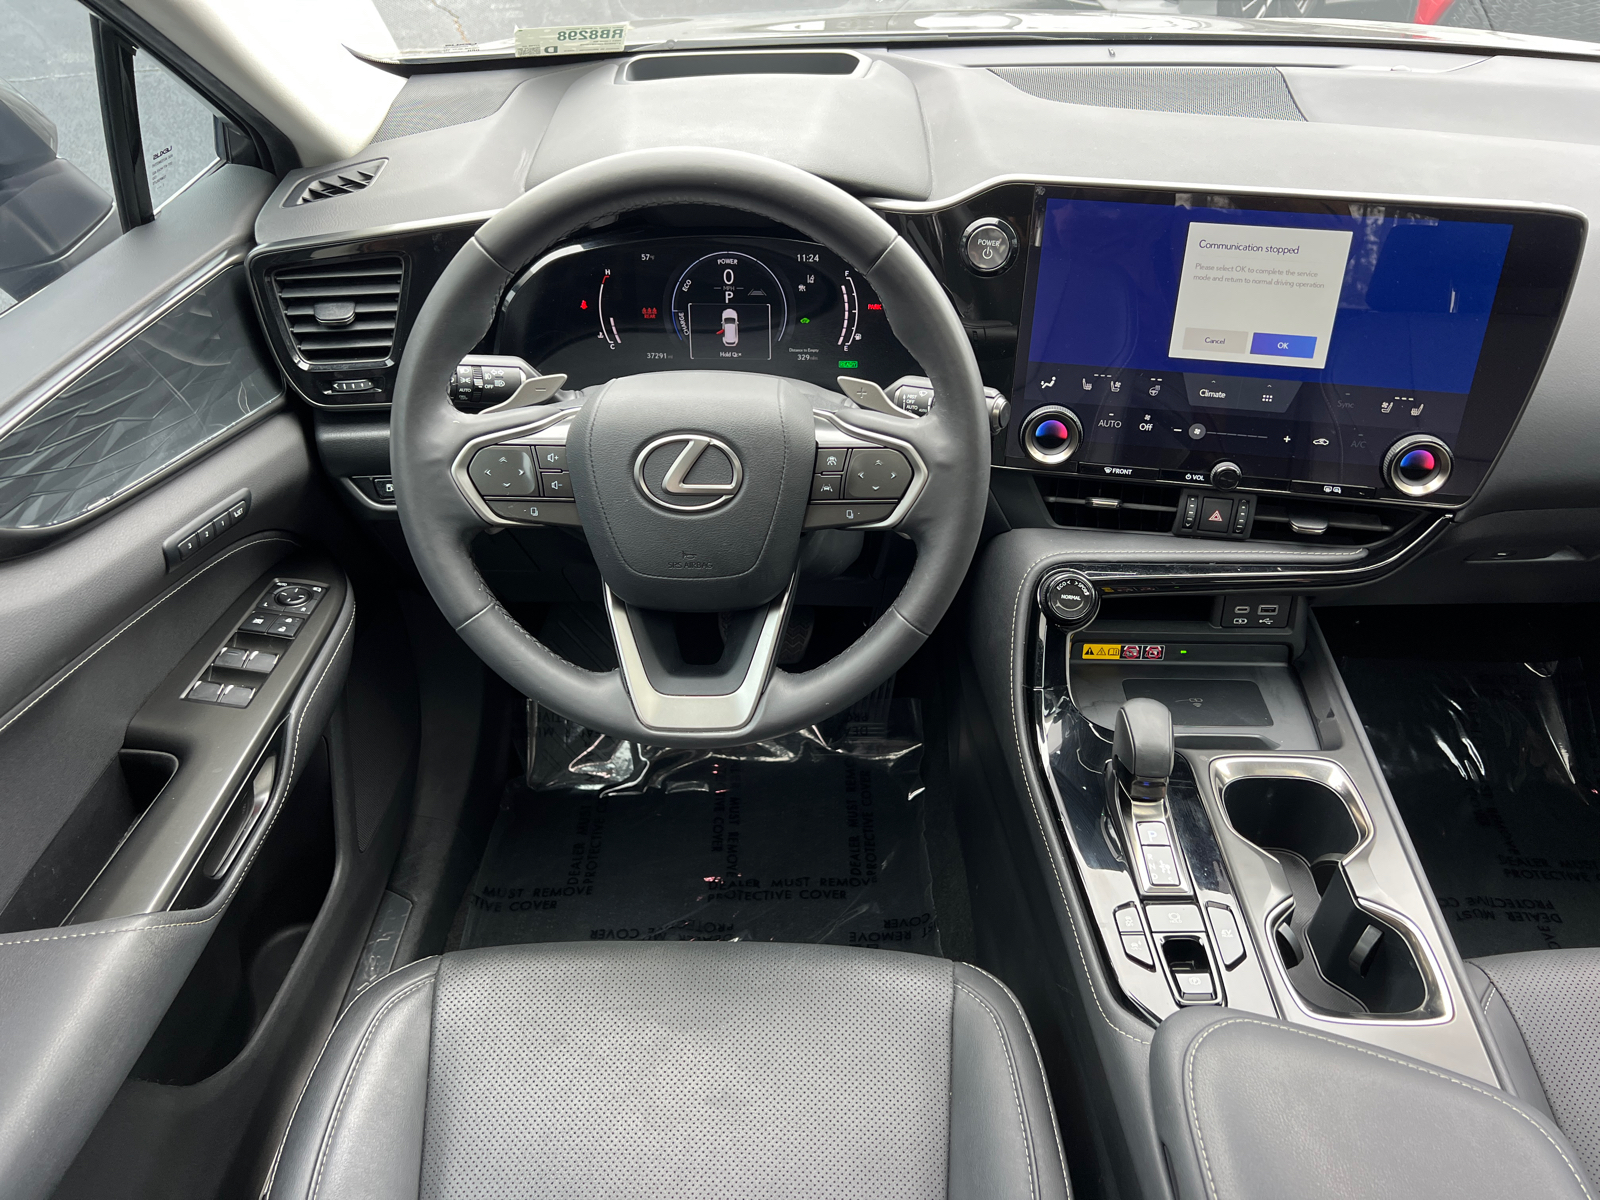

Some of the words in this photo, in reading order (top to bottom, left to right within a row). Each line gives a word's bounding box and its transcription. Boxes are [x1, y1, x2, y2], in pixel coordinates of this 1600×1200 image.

[977, 238, 1000, 247] POWER
[1198, 239, 1263, 252] Communication
[1265, 245, 1300, 256] stopped
[797, 253, 819, 262] 11:24
[604, 268, 611, 276] H
[723, 268, 734, 285] 0
[1195, 262, 1215, 272] Please
[1216, 264, 1234, 273] select
[1235, 265, 1247, 273] OK
[1255, 267, 1284, 277] complete
[1285, 268, 1295, 277] the
[1297, 270, 1318, 278] service
[682, 279, 692, 292] ECO
[1193, 273, 1211, 281] mode
[1212, 274, 1224, 282] and
[1251, 277, 1273, 286] normal
[1273, 278, 1295, 289] driving
[1295, 281, 1325, 290] operation
[725, 291, 734, 304] P
[678, 312, 690, 336] CHARGE
[1204, 336, 1226, 345] Cancel
[1277, 341, 1290, 350] OK
[1199, 388, 1226, 399] Climate
[1337, 400, 1354, 409] Sync
[1098, 419, 1122, 429] AUTO
[1139, 422, 1154, 432] Off
[1350, 440, 1367, 449] A/C
[1112, 468, 1133, 476] FRONT
[1192, 474, 1205, 482] VOL
[667, 561, 682, 570] SRS
[683, 561, 713, 570] AIRBAG
[1056, 581, 1067, 591] ECO
[859, 769, 872, 806] COVER
[576, 804, 592, 836] MUST
[846, 798, 858, 828] MUST
[711, 816, 724, 852] COVER
[1146, 830, 1158, 842] P
[861, 807, 878, 877] PROTECTIVE
[726, 831, 740, 878] REMOVE
[848, 835, 862, 877] DEALER
[567, 841, 586, 886] DEALER
[708, 877, 760, 891] DEALER
[771, 876, 811, 888] MUST
[819, 874, 878, 888] REMOVE
[1503, 868, 1591, 883] PROTECTIVE
[482, 885, 524, 899] MUST
[532, 885, 593, 898] REMOVE
[707, 889, 792, 902] PROTECTIVE
[799, 888, 847, 900] COVER
[508, 899, 558, 912] COVER
[1464, 896, 1555, 910] PROTECTIVE
[883, 912, 931, 929] COVER
[1456, 908, 1496, 922] MUST
[1505, 910, 1563, 924] DEALER
[590, 928, 640, 940] COVER
[849, 930, 912, 943] REMOVE
